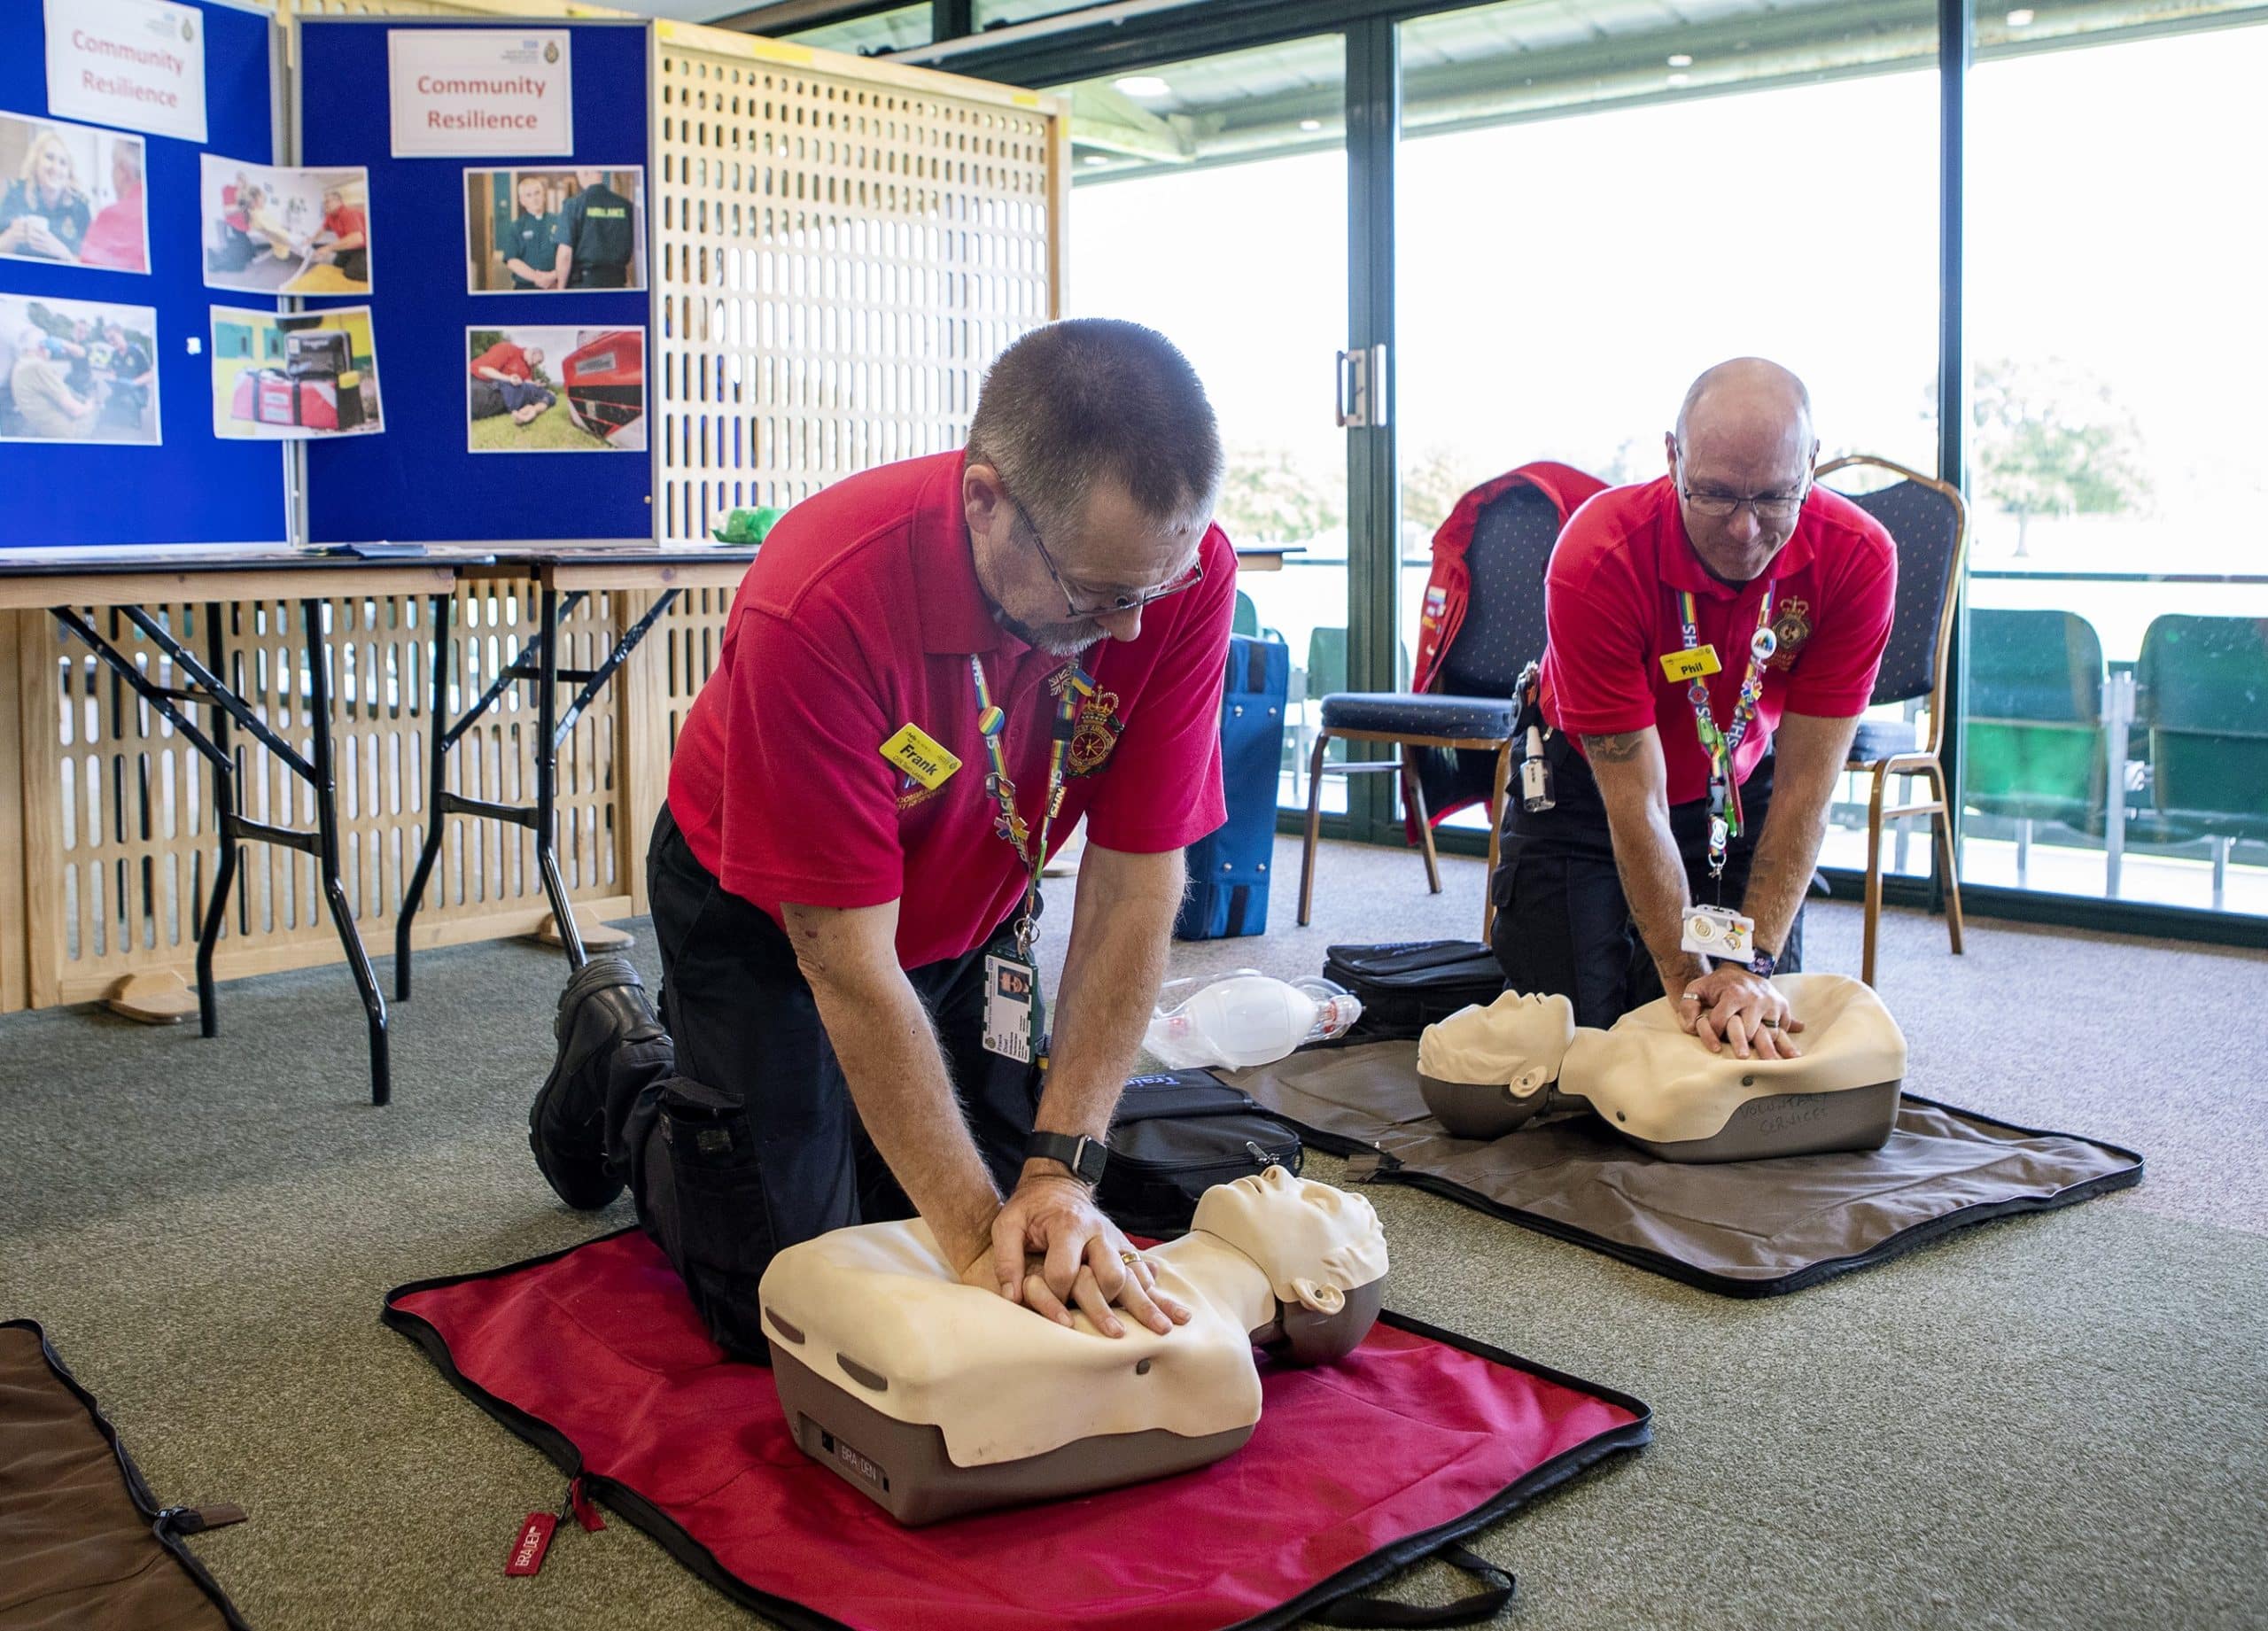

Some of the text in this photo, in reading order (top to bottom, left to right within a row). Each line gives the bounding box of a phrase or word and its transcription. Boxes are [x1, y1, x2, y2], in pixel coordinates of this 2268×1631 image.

[72, 28, 184, 77] Community
[82, 68, 179, 109] Resilience
[417, 75, 547, 99] Community
[427, 110, 539, 129] Resilience
[1682, 624, 1697, 648] HS
[1681, 661, 1704, 675] Phil
[899, 743, 938, 776] Frank
[841, 1445, 876, 1481] BRADEN
